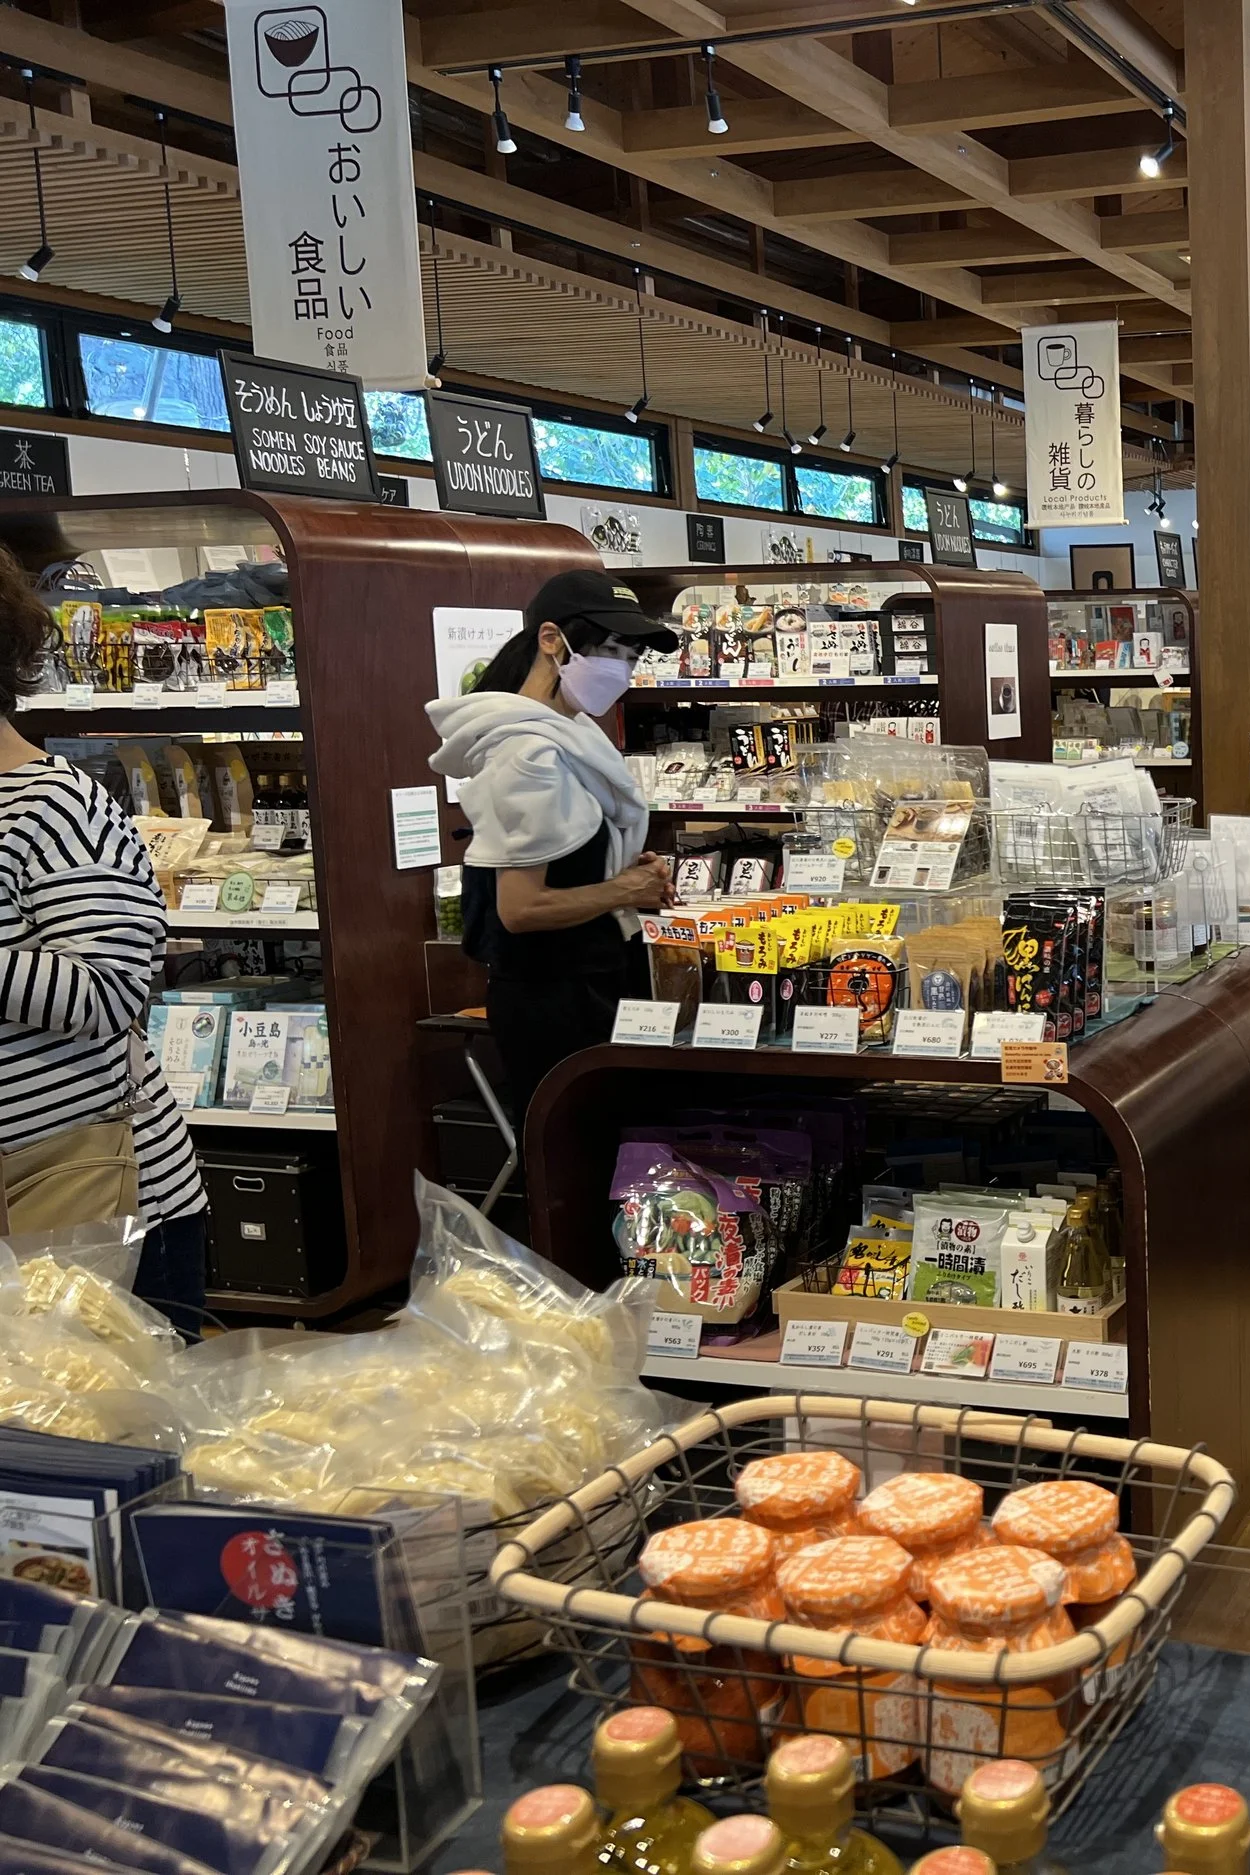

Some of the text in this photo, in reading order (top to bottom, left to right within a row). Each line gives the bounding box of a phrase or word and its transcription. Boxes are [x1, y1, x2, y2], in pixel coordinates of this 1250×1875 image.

[327, 142, 373, 320] おいしい
[288, 231, 329, 321] 食品
[317, 326, 354, 341] Food
[324, 344, 348, 356] 食品
[235, 379, 357, 429] そうめん しょうゆ豆
[252, 428, 365, 461] SOMEN SOY SAUCE
[457, 415, 513, 461] うどん
[1074, 402, 1095, 491] 暮らしの
[14, 439, 36, 470] 茶
[250, 450, 356, 483] NOODLES BEANS
[1048, 441, 1072, 491] 雑貨
[0, 471, 56, 494] GREEN TEA
[447, 460, 533, 498] UDON NOODLES
[1044, 494, 1107, 503] Local Products
[936, 501, 960, 529] うどん
[757, 931, 768, 969] もろみ
[239, 1022, 281, 1038] 小豆島
[639, 1025, 657, 1033] ¥216
[820, 1032, 838, 1040] ¥277
[711, 1206, 746, 1312] 夜漬の素
[925, 1253, 986, 1275] 一時間漬
[691, 1268, 708, 1302] パック
[664, 1337, 681, 1345] ¥563
[876, 1350, 894, 1358] ¥291
[1018, 1361, 1037, 1369] ¥695
[1090, 1369, 1109, 1377] ¥378
[264, 1528, 299, 1621] さぬき
